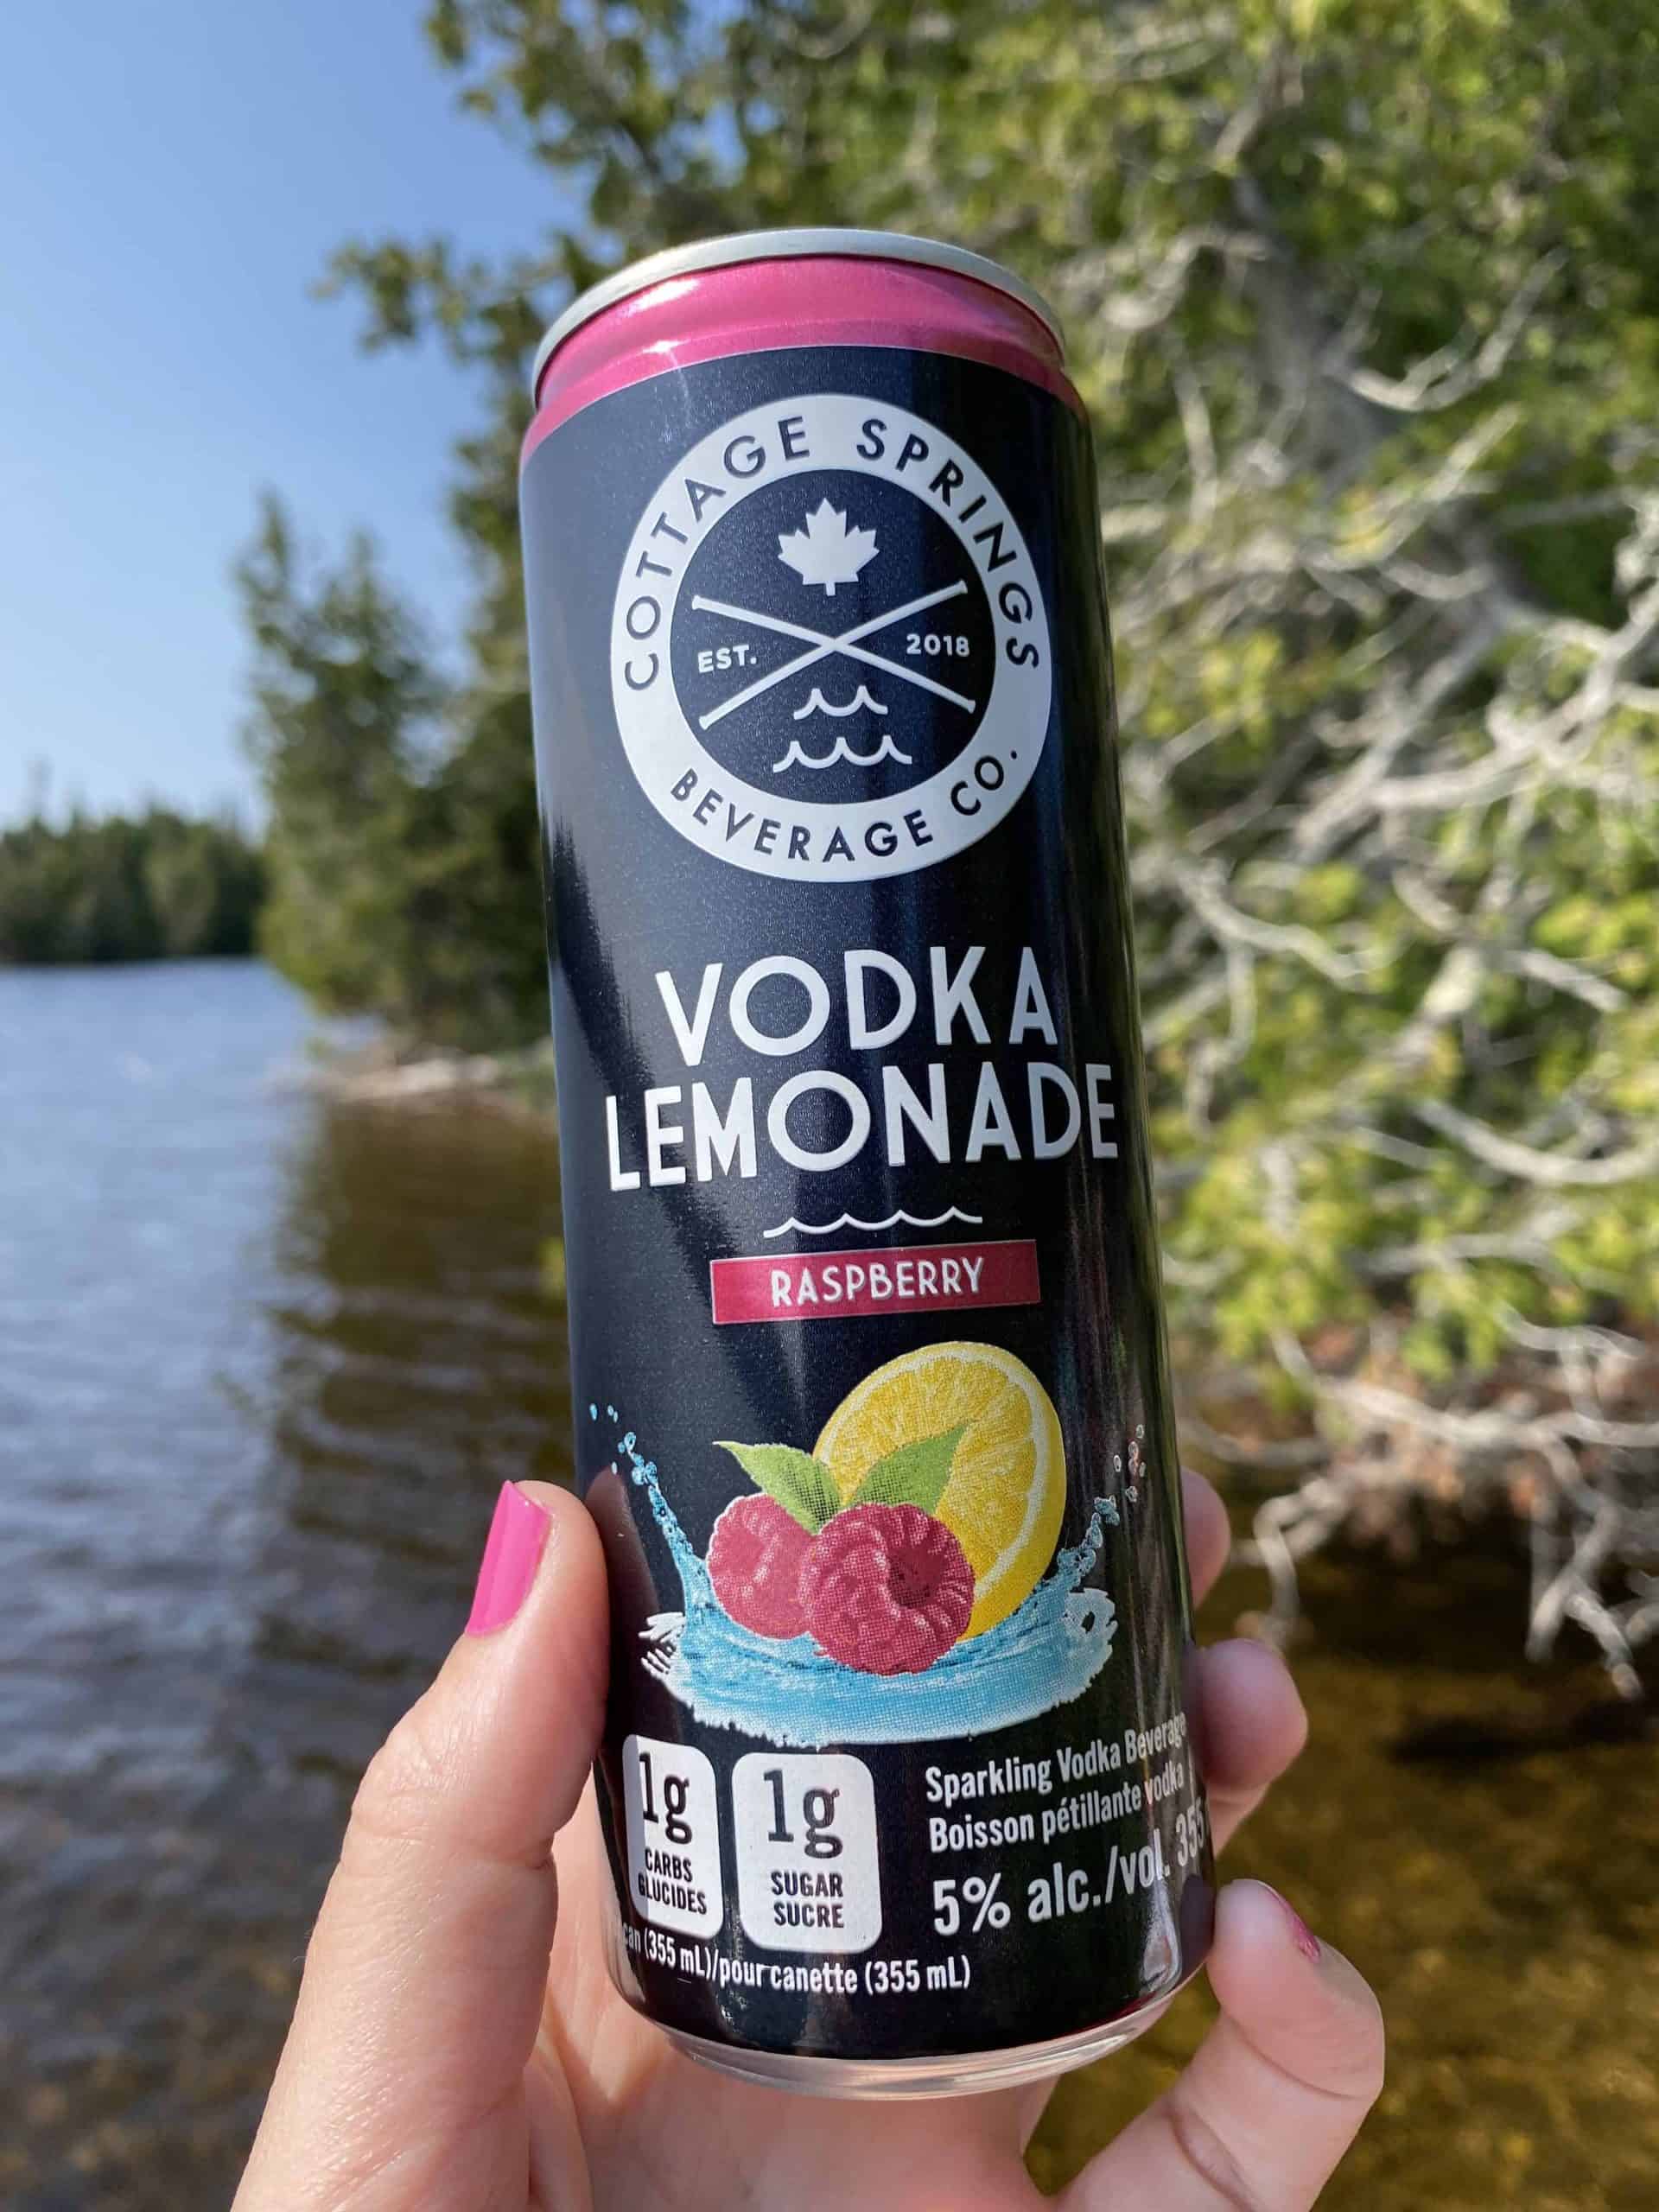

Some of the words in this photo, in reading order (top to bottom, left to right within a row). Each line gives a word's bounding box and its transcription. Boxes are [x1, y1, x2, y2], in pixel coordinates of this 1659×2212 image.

[624, 416, 810, 691] COTTAGE
[856, 418, 1039, 670] SPRINGS
[696, 645, 758, 673] EST.
[906, 634, 970, 658] 2018
[670, 768, 933, 863] BEVERAGE
[950, 749, 1019, 817] CO.
[655, 945, 1058, 1066] VODKA
[606, 1061, 1119, 1192] LEMONADE
[771, 1255, 985, 1308] RASPBERRY
[639, 1751, 693, 1846] 1g
[925, 1755, 1053, 1808] Sparkling
[1056, 1738, 1122, 1783] Vodka
[929, 1814, 1035, 1853] Boisson
[1041, 1781, 1142, 1844] pétillante
[1144, 1760, 1185, 1805] vodka
[763, 1769, 843, 1859] 1g
[637, 1872, 708, 1916] GLUCIDES
[644, 1847, 694, 1883] CARBS
[771, 1870, 844, 1898] SUGAR
[932, 1872, 1012, 1936] 5%
[1027, 1827, 1170, 1923] alc./vol.
[773, 1900, 845, 1929] SUCRE
[644, 1926, 677, 1968] (355
[770, 1961, 858, 1994] canette
[865, 1960, 920, 1996] (355
[925, 1954, 970, 1989] mL)
